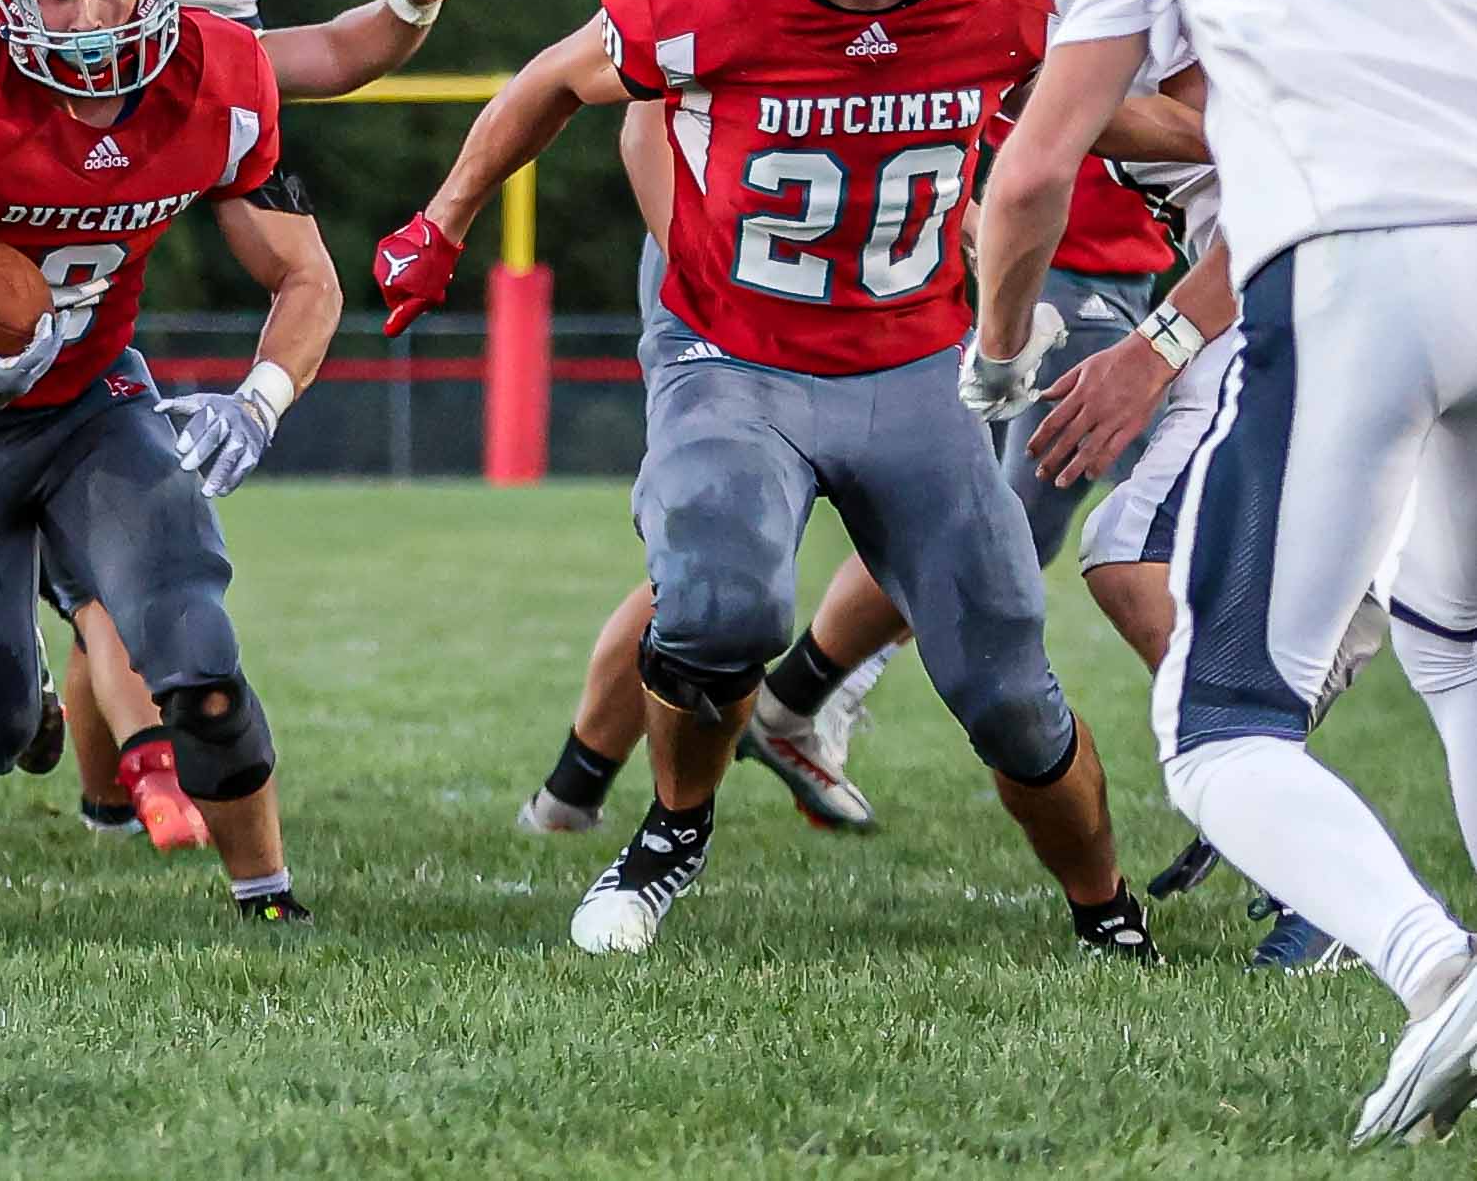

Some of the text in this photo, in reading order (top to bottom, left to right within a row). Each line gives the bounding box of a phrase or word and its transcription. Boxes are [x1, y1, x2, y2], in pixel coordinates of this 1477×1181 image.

[845, 42, 898, 56] adidas
[757, 89, 981, 137] DUTCHMEN
[84, 155, 130, 169] adidas
[1, 190, 200, 232] DUTCHMEN
[731, 143, 969, 303] 20
